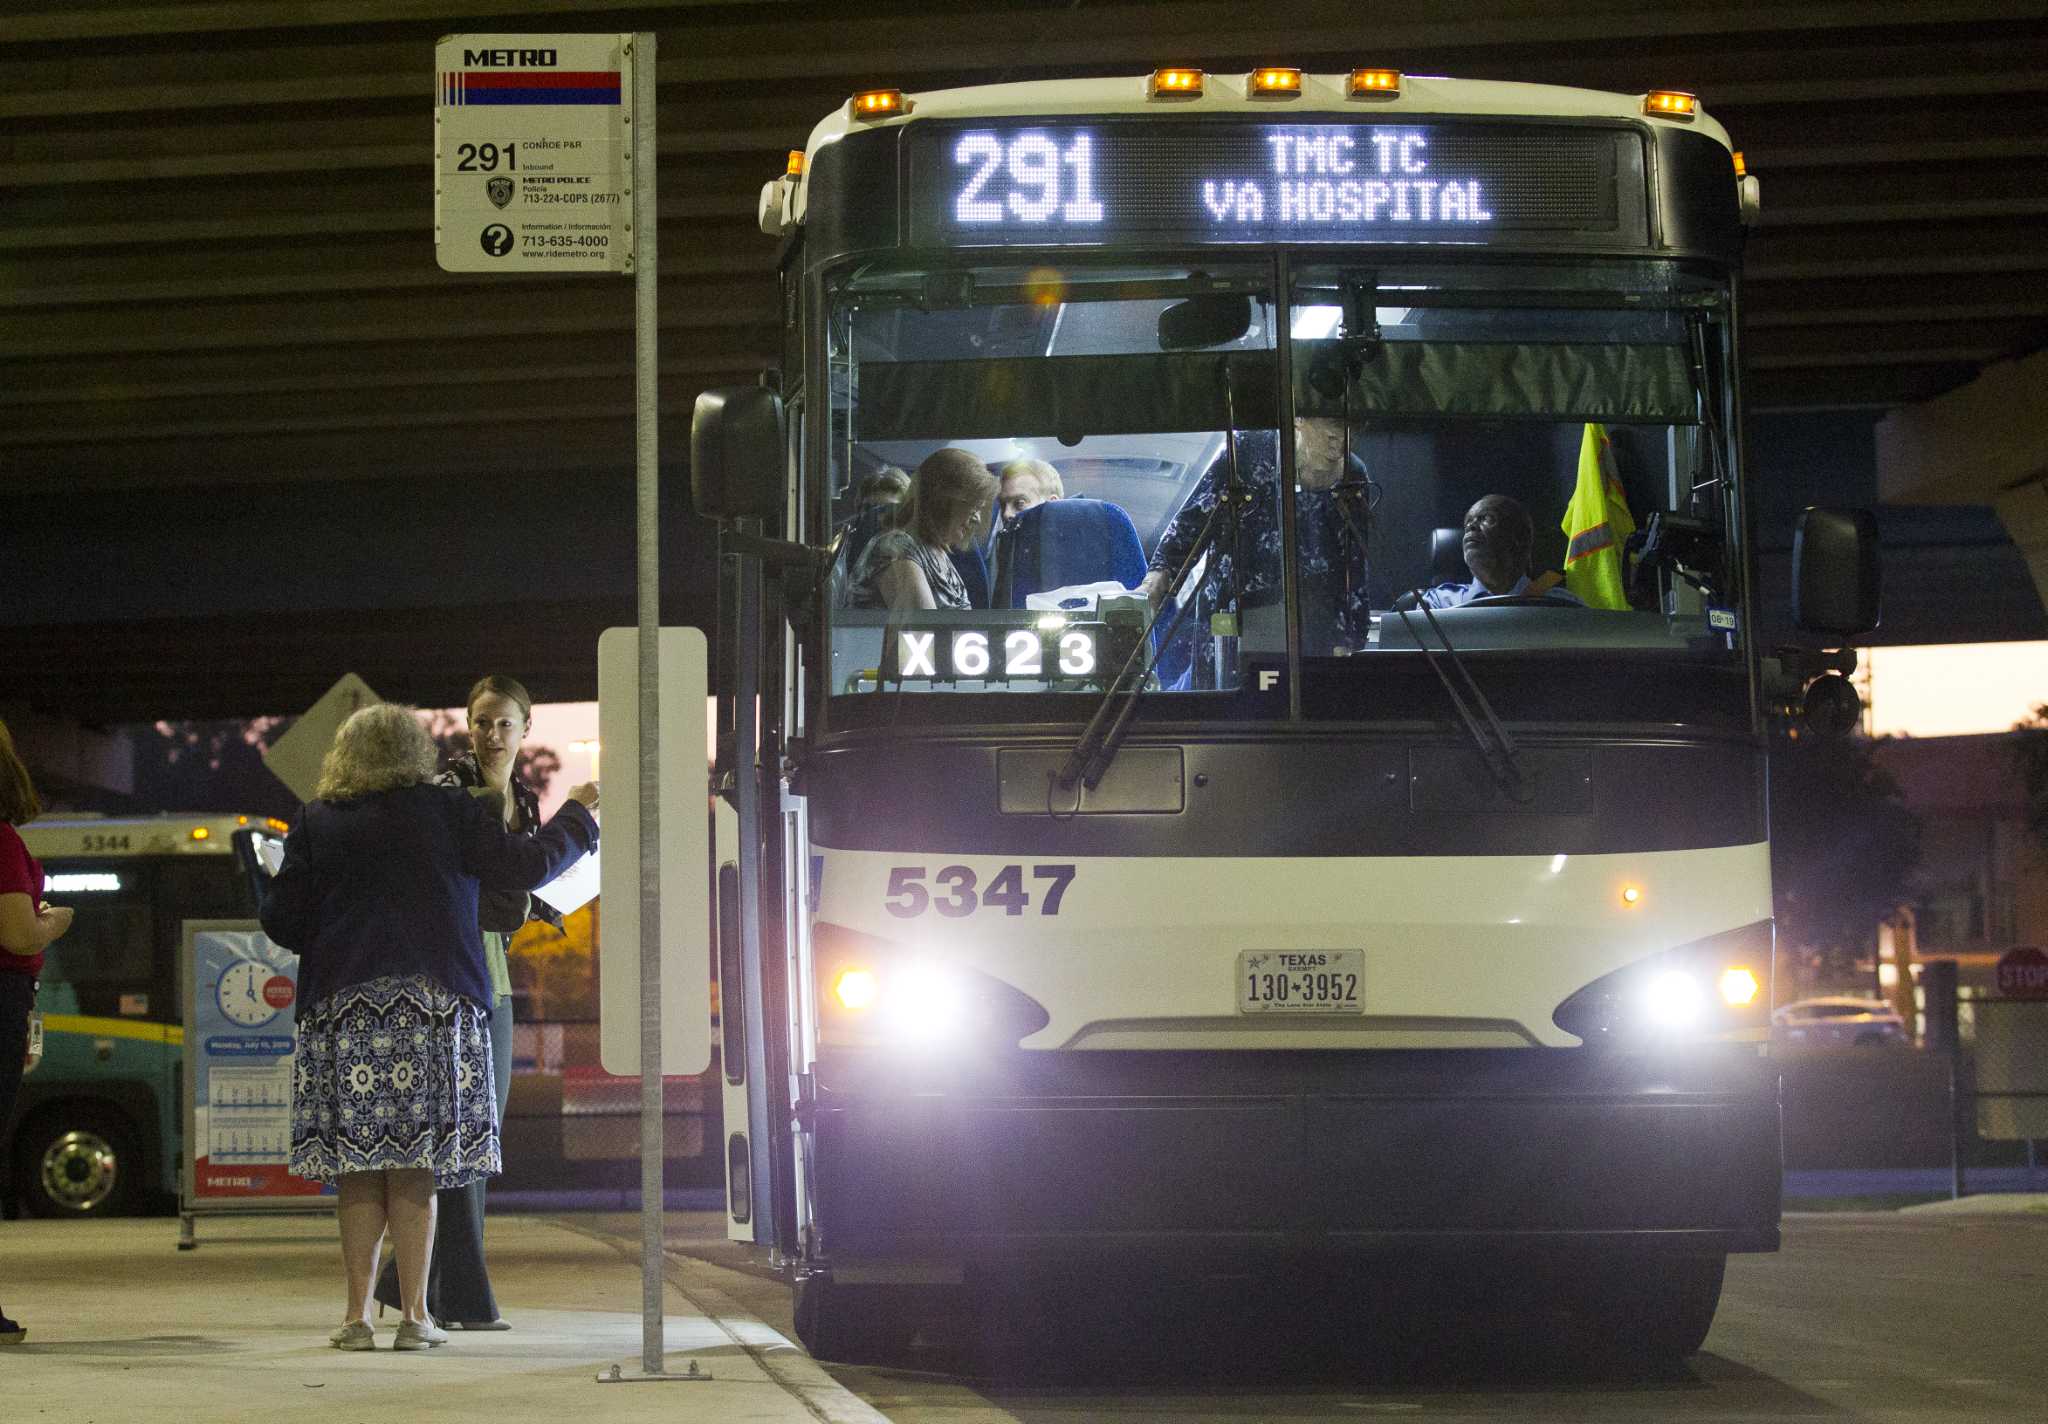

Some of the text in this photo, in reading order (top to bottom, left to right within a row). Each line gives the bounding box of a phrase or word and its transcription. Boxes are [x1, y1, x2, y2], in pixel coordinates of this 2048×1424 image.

[463, 49, 557, 67] METRO
[522, 141, 582, 150] CONROE P&R
[1267, 134, 1427, 174] TMC TC
[457, 142, 516, 172] 291
[955, 133, 1104, 223] 291
[523, 194, 621, 205] 713-224-COPS (2677)
[1200, 180, 1493, 222] VA HOSPITAL
[522, 236, 609, 247] 713-635-4000
[522, 250, 605, 259] www.ridemetro.org
[1258, 670, 1280, 691] F
[885, 864, 1076, 919] 5347
[1279, 954, 1327, 966] TEXAS
[207, 1177, 251, 1187] METRO
